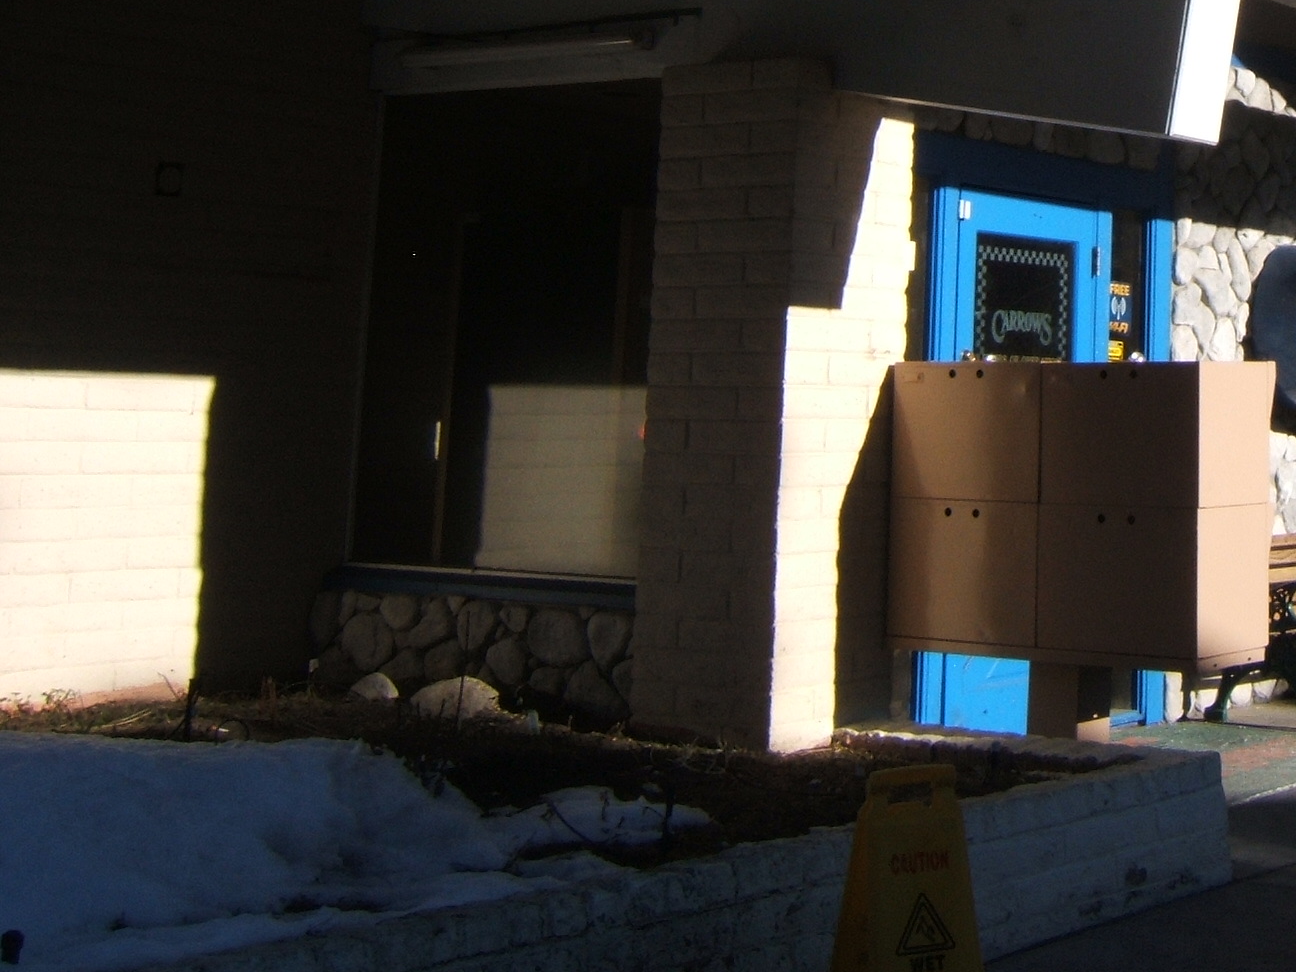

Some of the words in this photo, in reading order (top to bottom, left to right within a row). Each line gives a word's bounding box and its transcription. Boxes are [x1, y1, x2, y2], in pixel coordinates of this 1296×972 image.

[1110, 283, 1130, 297] FREE
[991, 309, 1052, 346] CARROWS
[890, 851, 951, 875] CAUTION
[909, 954, 946, 972] WET
